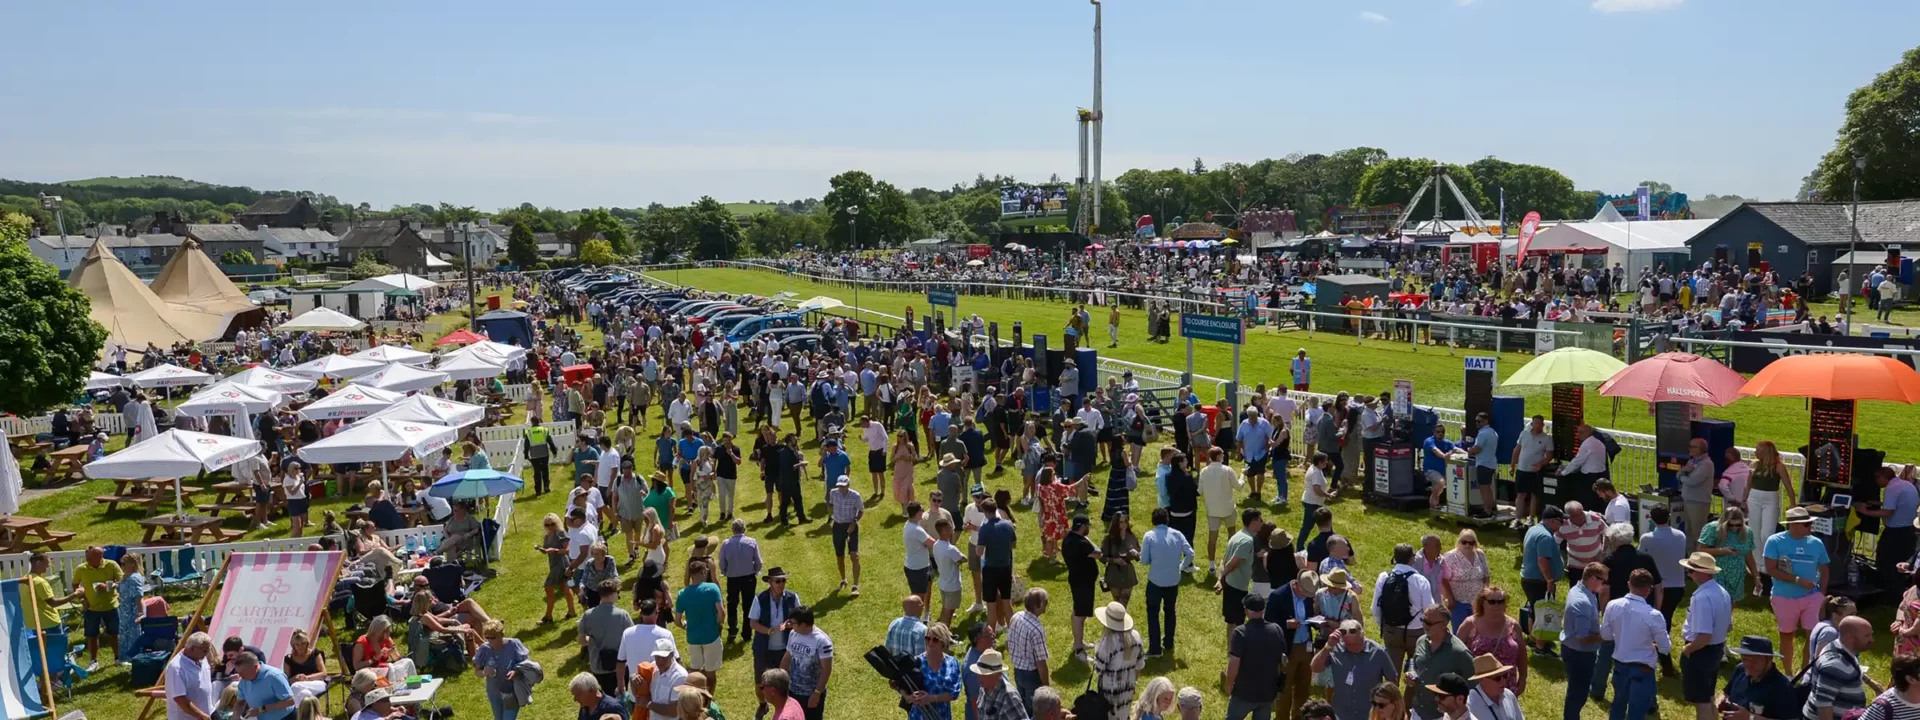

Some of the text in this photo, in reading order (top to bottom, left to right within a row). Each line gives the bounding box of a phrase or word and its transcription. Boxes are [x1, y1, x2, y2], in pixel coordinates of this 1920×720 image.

[1184, 317, 1238, 330] TO COURSE ENCLOSURE
[1464, 357, 1496, 369] MATT
[1666, 386, 1709, 399] HALLSPORTS
[230, 605, 305, 618] CARTMEL
